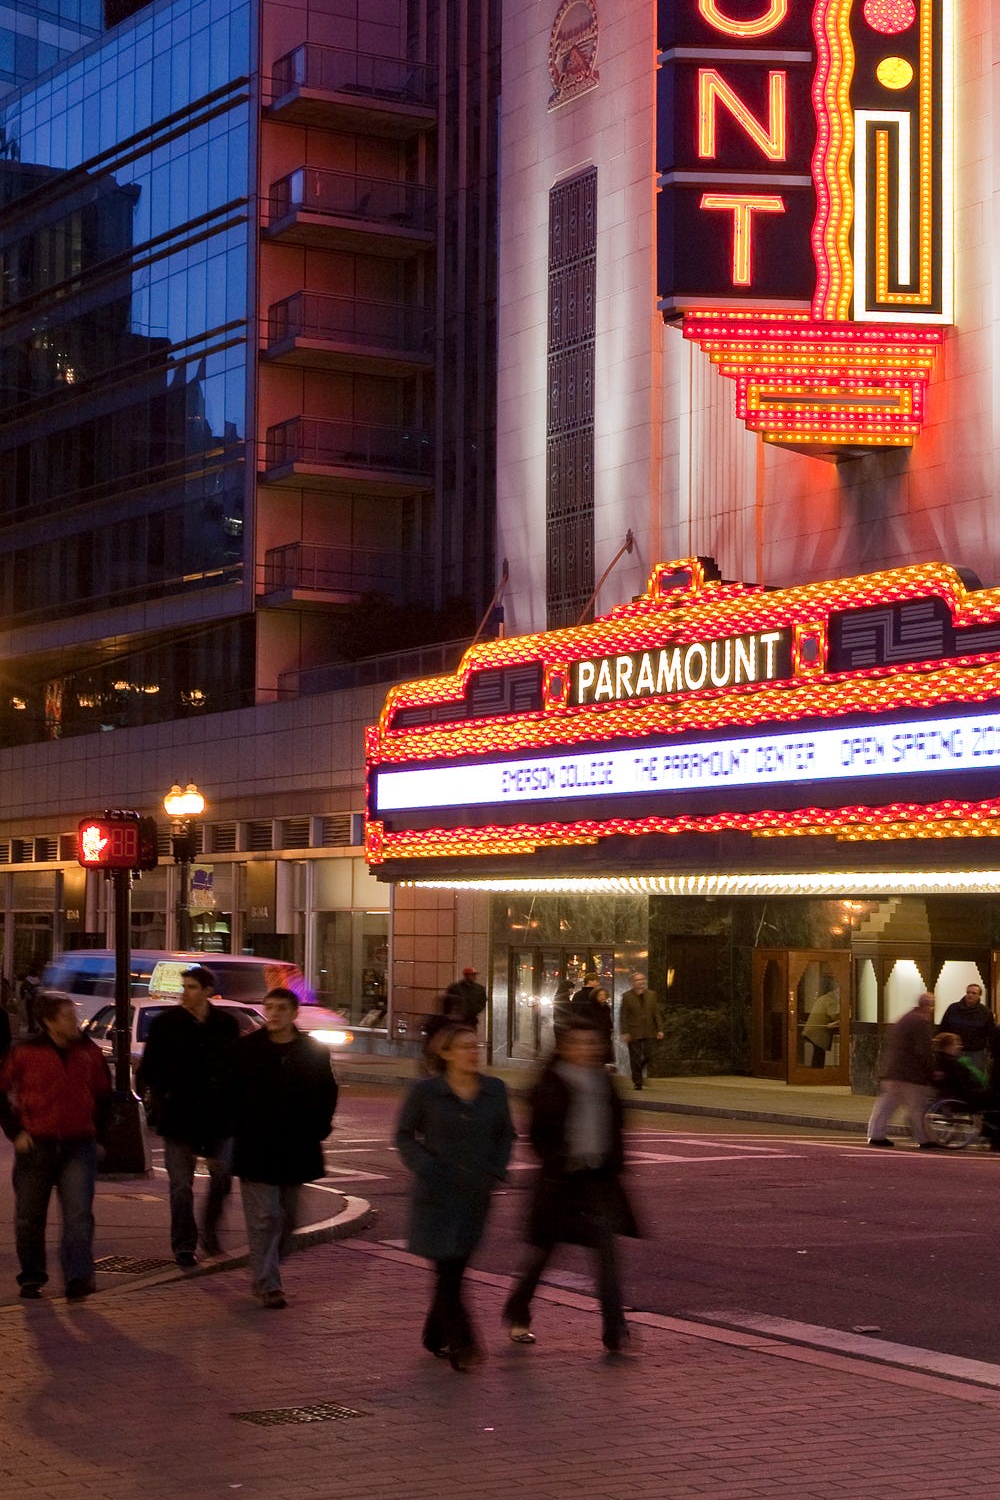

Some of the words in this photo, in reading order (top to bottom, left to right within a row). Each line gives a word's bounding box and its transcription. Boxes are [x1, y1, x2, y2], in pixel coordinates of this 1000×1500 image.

[578, 631, 781, 703] PARAMOUNT
[502, 766, 556, 792] EMERSON
[560, 760, 614, 788] COLLEGE
[634, 756, 659, 783] THE
[664, 747, 749, 780] PARAMOUNT
